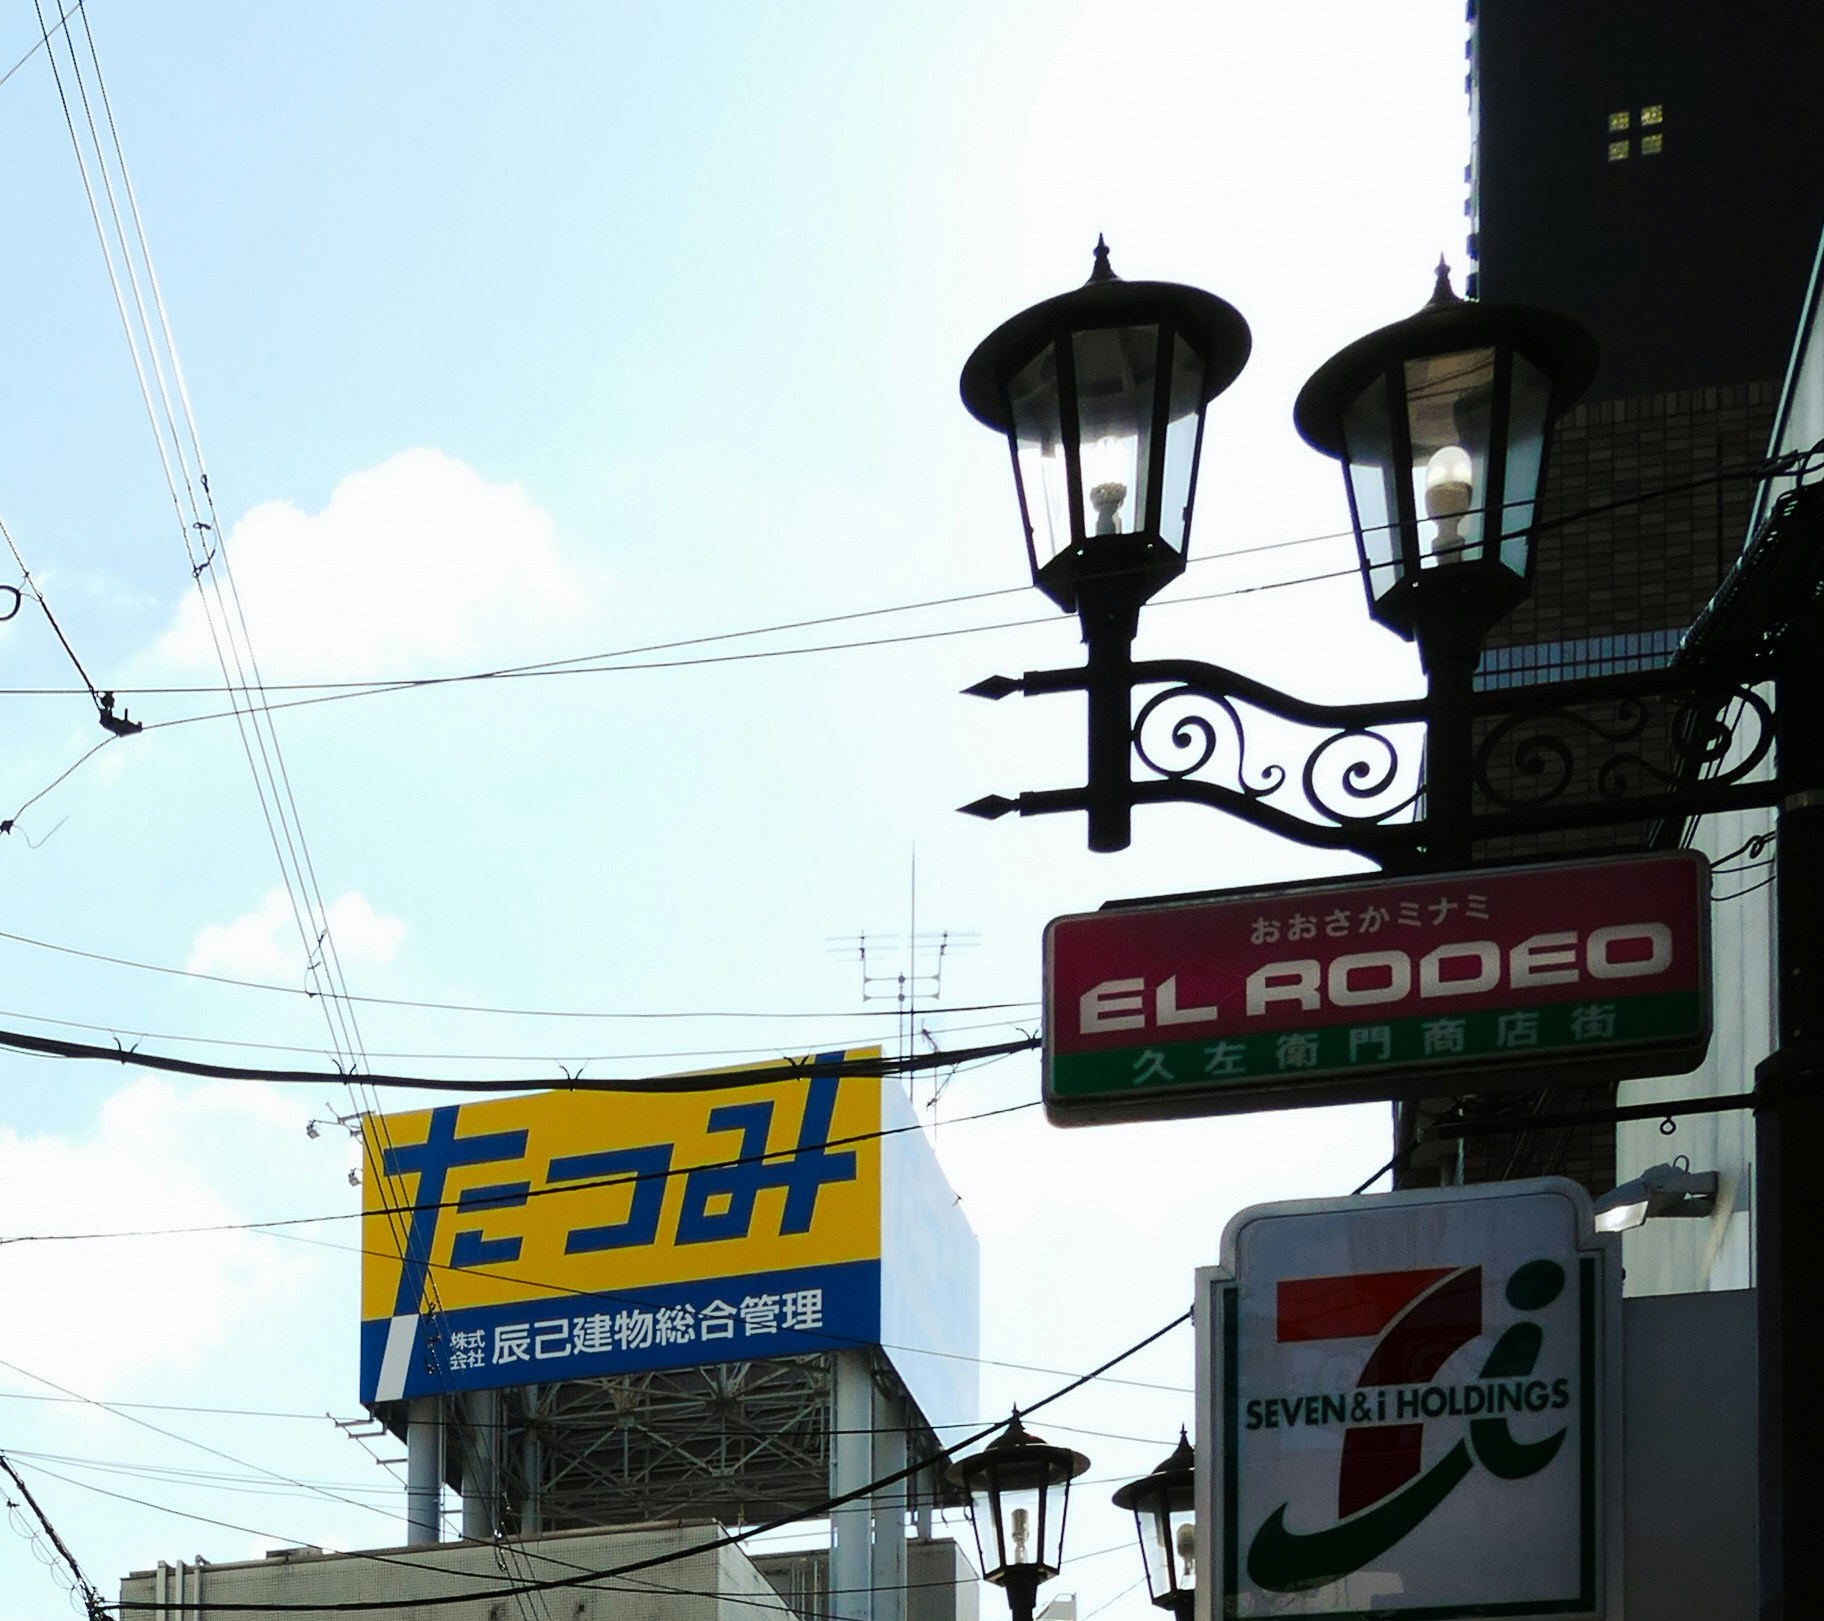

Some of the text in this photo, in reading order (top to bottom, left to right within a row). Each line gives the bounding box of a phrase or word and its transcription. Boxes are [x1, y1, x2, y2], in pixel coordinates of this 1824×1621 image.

[1249, 894, 1491, 945] おおさかミナミ
[1080, 922, 1673, 1035] EL RODEO
[1133, 1004, 1617, 1086] 久左衛門商店街
[376, 1050, 857, 1401] たつみ
[1397, 1378, 1569, 1420] HOLDINGS
